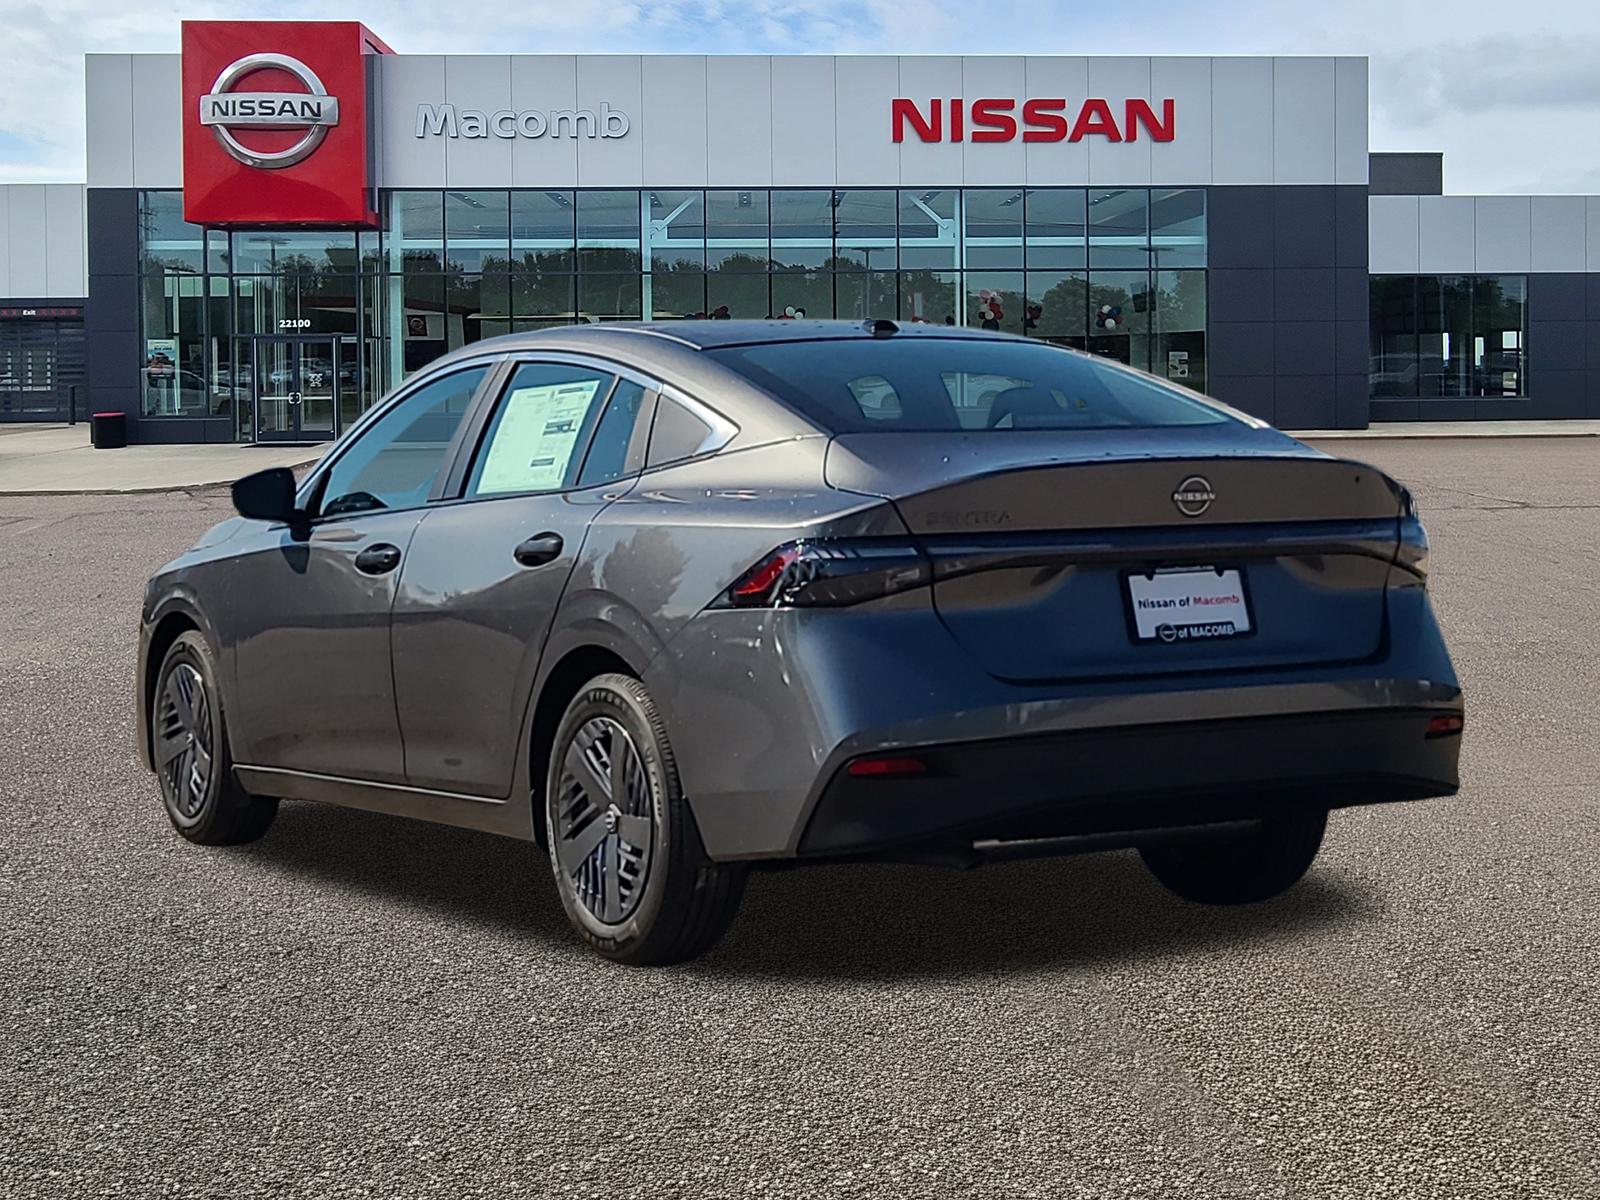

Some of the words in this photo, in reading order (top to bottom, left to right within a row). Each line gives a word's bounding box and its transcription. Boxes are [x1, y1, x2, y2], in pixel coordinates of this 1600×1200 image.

[212, 100, 322, 118] NISSAN
[415, 102, 630, 139] Macomb
[891, 98, 1175, 143] NISSAN
[279, 319, 311, 328] 22100
[1173, 492, 1216, 501] NISSAN
[1138, 598, 1177, 609] Nissan
[1179, 597, 1190, 607] of
[1193, 594, 1240, 606] Macomb
[1178, 628, 1188, 638] of
[1190, 624, 1235, 637] MACOMB
